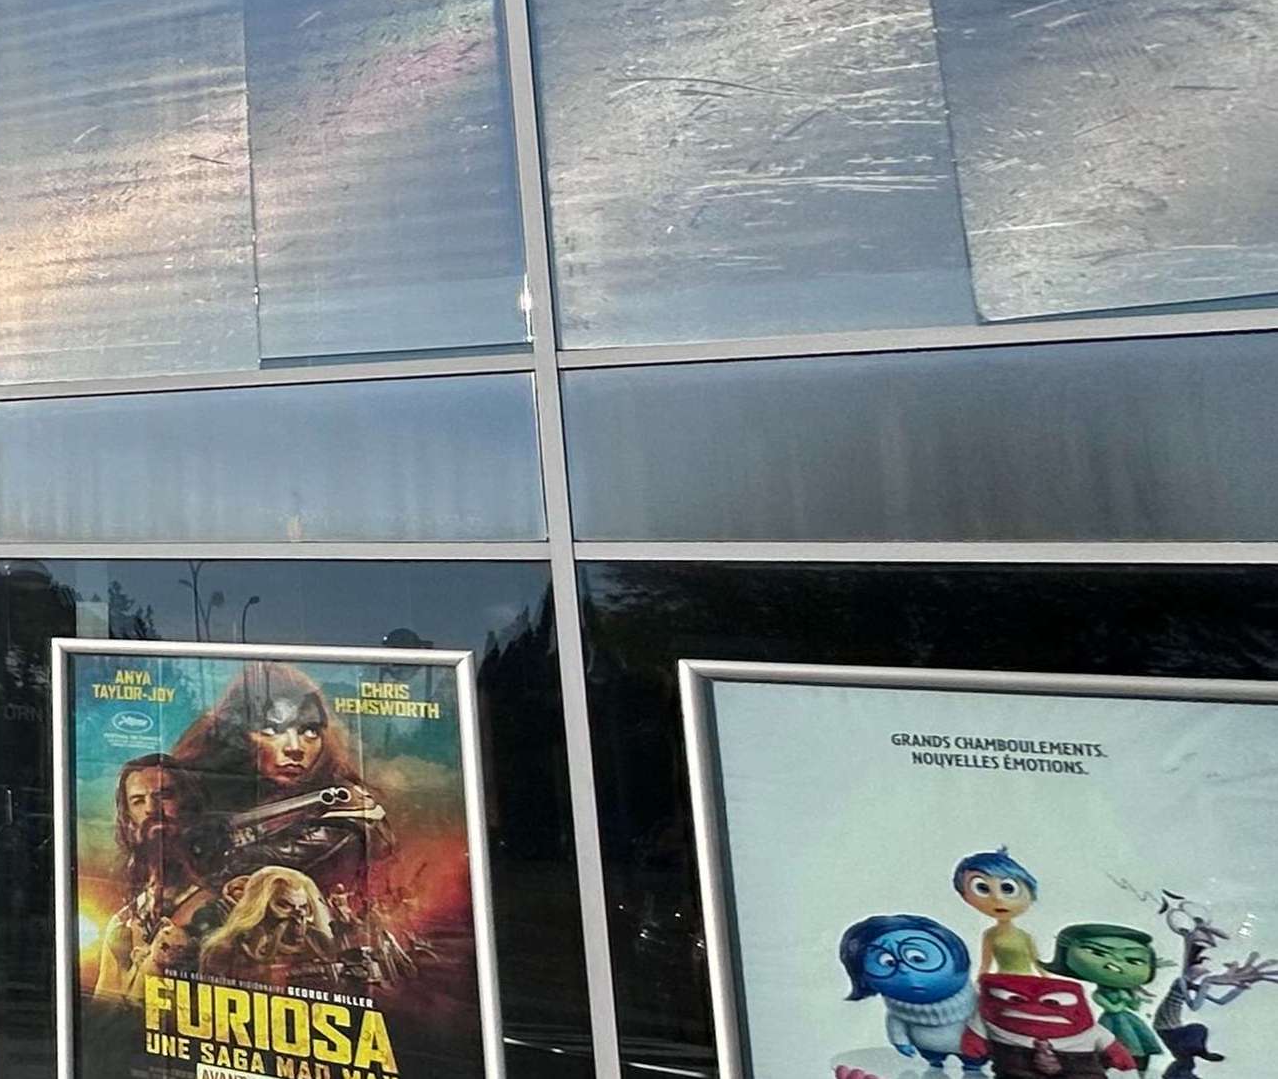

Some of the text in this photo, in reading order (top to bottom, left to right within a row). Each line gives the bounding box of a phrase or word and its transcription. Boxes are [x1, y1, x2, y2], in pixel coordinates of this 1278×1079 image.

[115, 669, 152, 686] ANYA
[91, 684, 176, 702] TAYLOR-JOY
[361, 682, 410, 700] CHRIS
[334, 697, 440, 719] HEMSWORTH
[890, 733, 1109, 758] GRANDS CHAMBOULEMENTS.
[912, 751, 1090, 775] NOUVELLES ÉMOTIONS.
[286, 986, 330, 1002] GEORGE
[333, 992, 374, 1009] MILLER
[144, 974, 400, 1074] FURIOSA
[146, 1031, 191, 1060] UNE
[200, 1041, 266, 1074] SAGA
[275, 1055, 332, 1079] MAD
